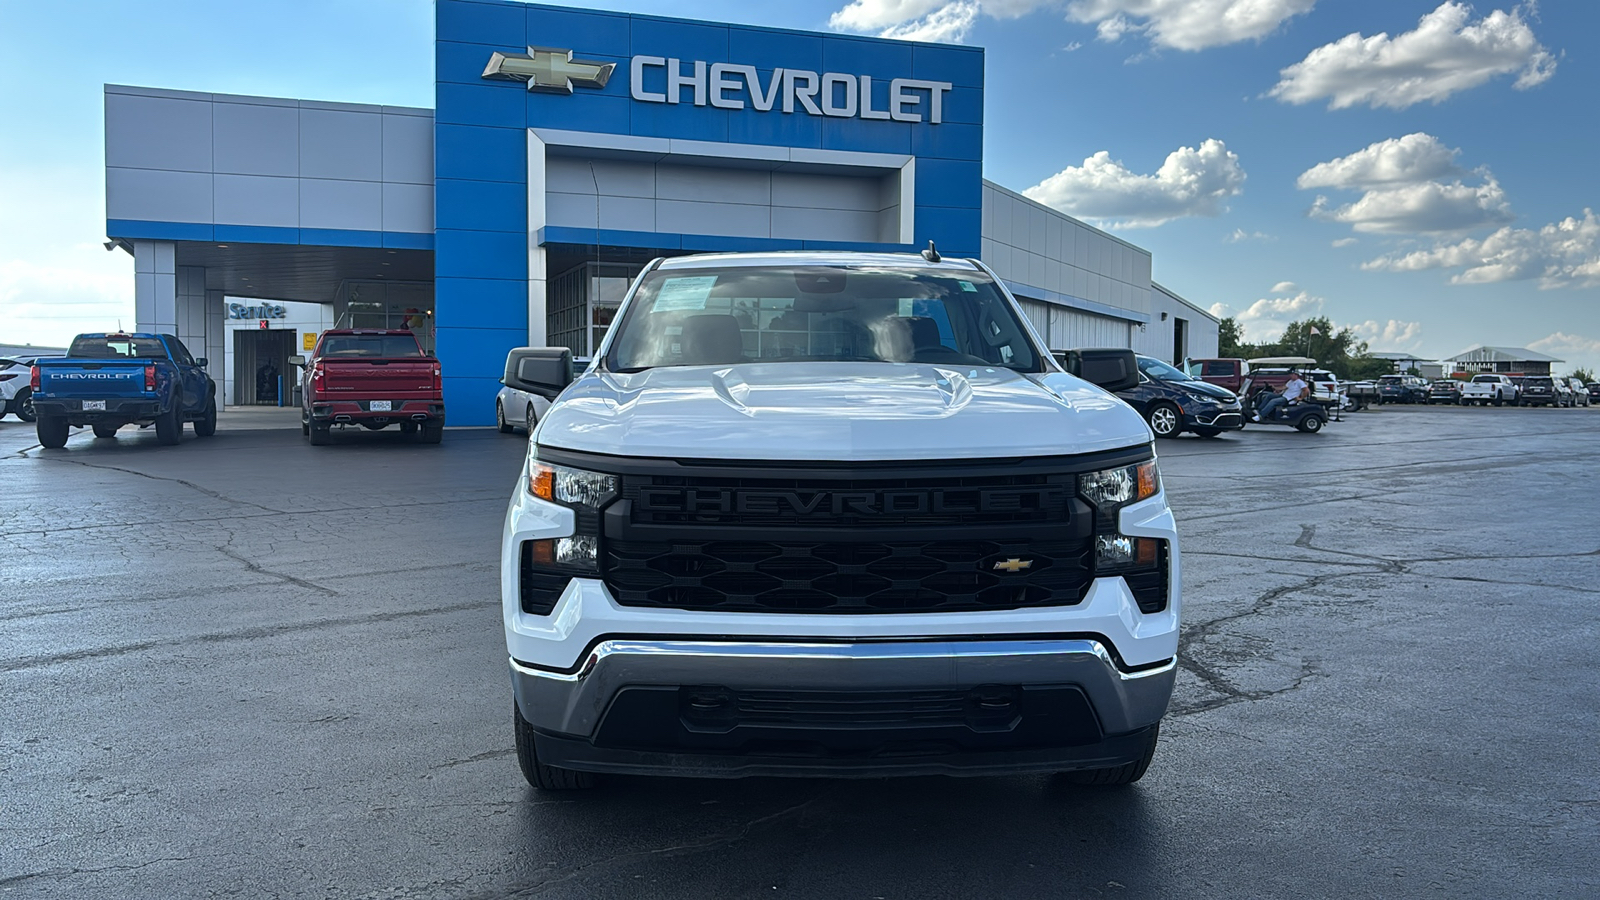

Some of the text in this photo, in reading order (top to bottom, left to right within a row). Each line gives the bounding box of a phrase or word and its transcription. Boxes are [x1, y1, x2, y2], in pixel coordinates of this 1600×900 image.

[631, 54, 953, 124] CHEVROLET
[229, 302, 283, 319] Service
[640, 487, 1065, 515] CHEVROLET
